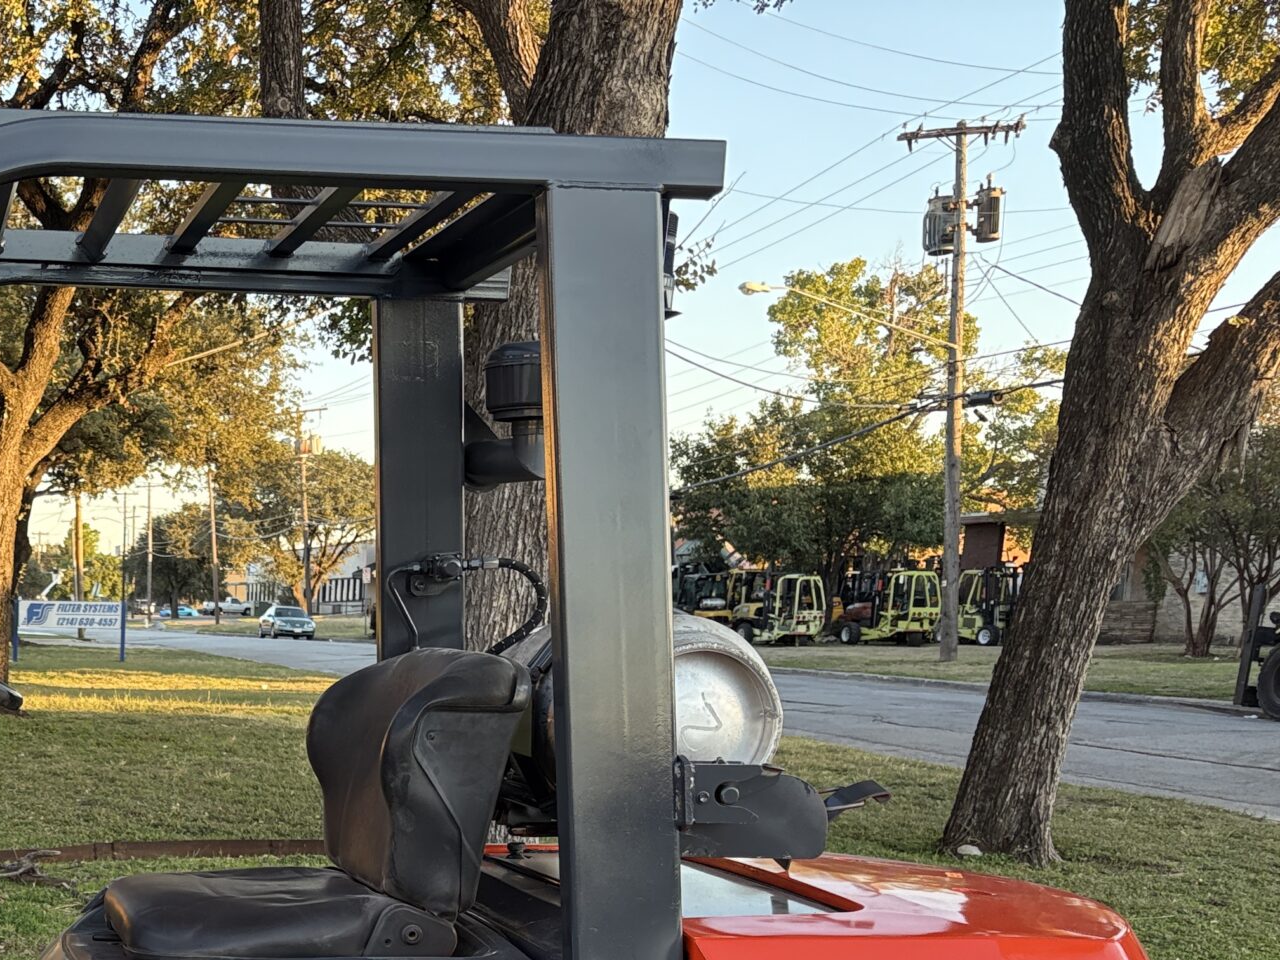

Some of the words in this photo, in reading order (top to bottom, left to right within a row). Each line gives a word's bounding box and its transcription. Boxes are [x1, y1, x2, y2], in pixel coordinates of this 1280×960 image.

[56, 603, 81, 613] FILTER
[82, 603, 119, 613] SYSTEMS
[56, 617, 77, 626] (214)
